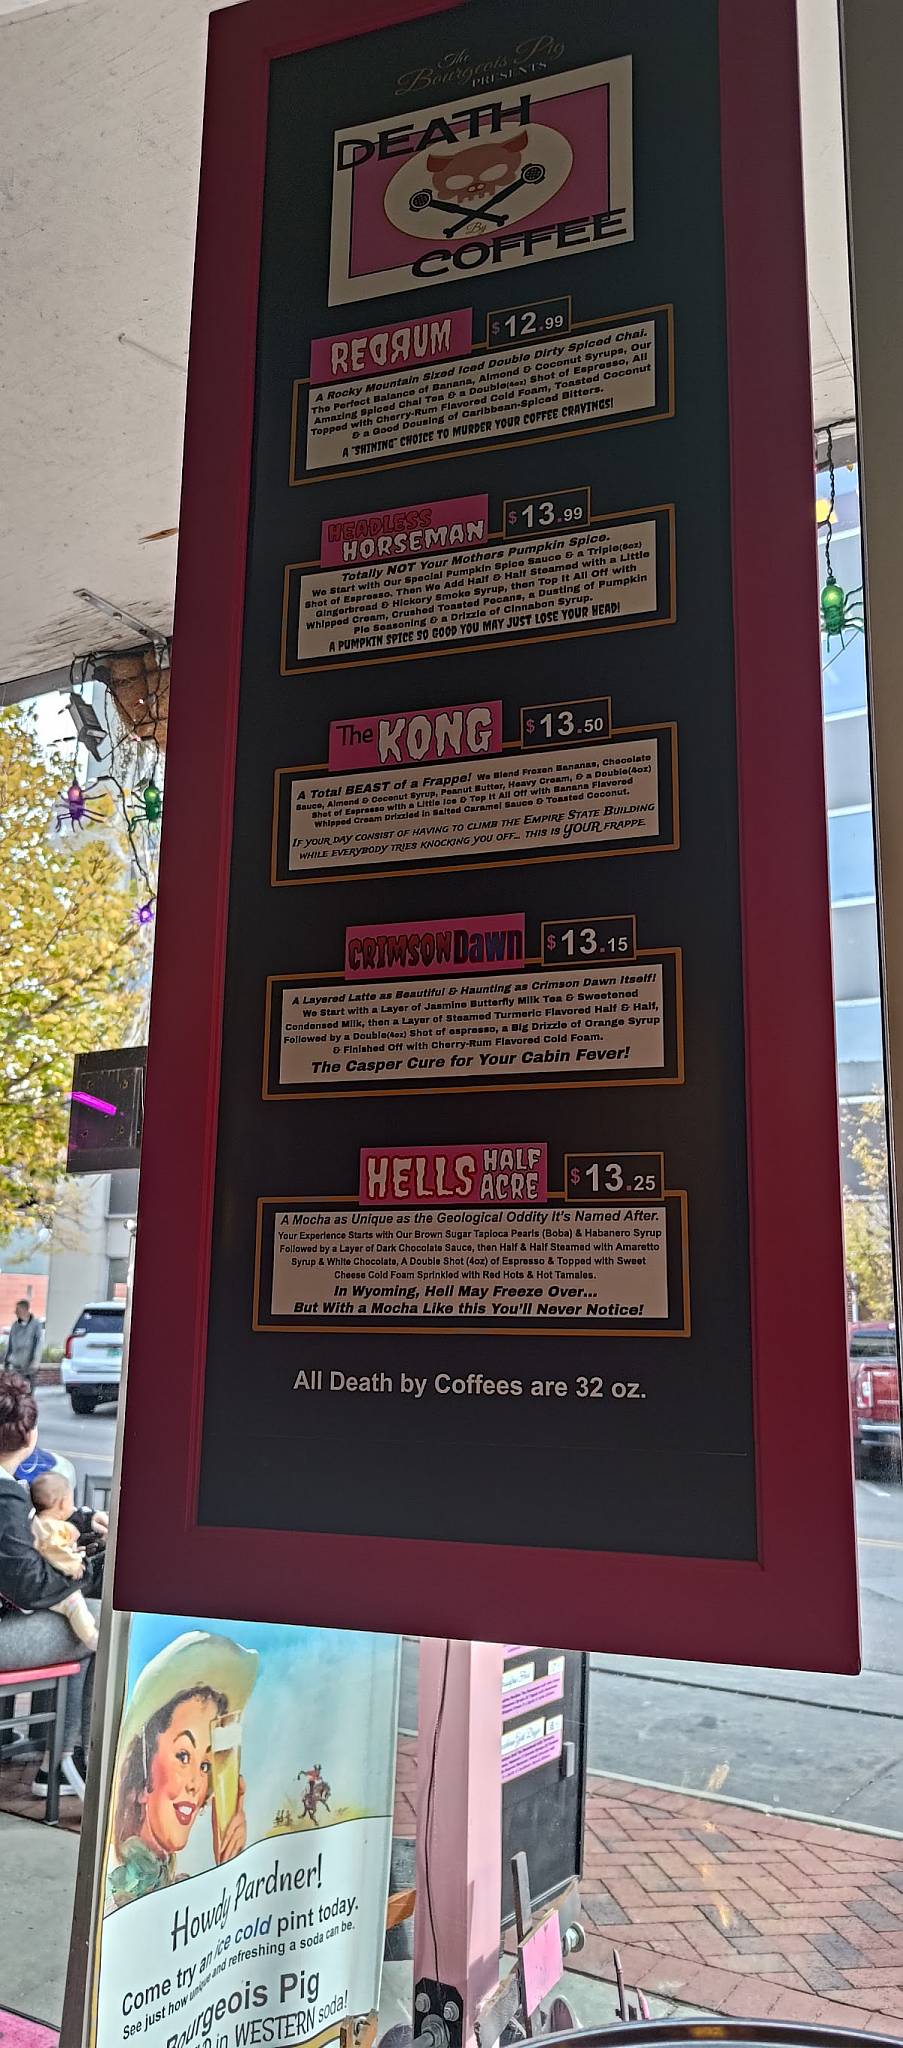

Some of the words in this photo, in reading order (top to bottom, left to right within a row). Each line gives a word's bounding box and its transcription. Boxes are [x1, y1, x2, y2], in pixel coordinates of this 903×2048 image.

[393, 56, 508, 96] Bourgeois
[514, 35, 564, 64] Pig
[438, 48, 471, 68] The
[472, 63, 546, 88] PRESENTS
[336, 94, 532, 171] DEATH
[411, 208, 627, 278] COFFEE
[314, 392, 324, 402] A
[326, 386, 363, 400] Rocky
[364, 375, 420, 393] Mountain
[422, 366, 456, 381] Sized
[457, 360, 486, 375] Iced
[487, 352, 531, 369] Double
[533, 346, 565, 360] Dirty
[567, 334, 612, 353] Spiced
[614, 327, 648, 342] Chai.
[331, 319, 452, 375] REDRUM
[310, 421, 348, 436] Topped
[350, 417, 373, 429] with
[375, 405, 438, 424] Cherry-Rum
[440, 395, 487, 412] Flavored
[489, 389, 515, 402] Cold
[517, 385, 551, 397] Foam,
[553, 372, 600, 390] Toasted
[602, 362, 651, 380] Coconut
[341, 447, 349, 458] A
[351, 437, 398, 456] "SHINING"
[399, 430, 434, 447] CHOICE
[436, 427, 449, 440] TO
[452, 420, 492, 438] MURDER
[494, 415, 521, 430] YOUR
[523, 407, 559, 425] COFFEE
[561, 396, 613, 418] CRAVINGS!
[327, 508, 433, 542] HEADLESS
[342, 519, 485, 563] HORSEMAN
[340, 567, 384, 582] Totally
[385, 561, 417, 576] NOT
[420, 558, 449, 570] Your
[450, 550, 505, 566] Mothers
[507, 539, 565, 557] Pumpkin
[568, 533, 611, 548] Spice.
[328, 641, 335, 653] A
[337, 634, 383, 652] PUMPKIN
[385, 630, 414, 645] SPICE
[416, 628, 429, 641] SO
[431, 625, 458, 639] GOOD
[459, 621, 480, 635] YOU
[482, 617, 505, 632] MAY
[506, 613, 532, 629] JUST
[534, 610, 559, 624] LOSE
[560, 606, 589, 621] YOUR
[591, 601, 620, 616] HEAD!
[337, 724, 373, 746] The
[377, 707, 492, 763] KONG
[296, 790, 306, 801] A
[309, 786, 342, 799] Total
[344, 780, 391, 795] BEAST
[393, 779, 408, 790] of
[409, 780, 419, 789] a
[422, 772, 472, 788] Frappe!
[476, 772, 491, 781] We
[492, 768, 520, 779] Blend
[522, 766, 553, 776] Frozen
[555, 761, 600, 772] Bananas,
[601, 754, 651, 767] Chocolate
[291, 996, 300, 1005] A
[302, 993, 346, 1006] Layered
[347, 992, 377, 1002] Latte
[378, 992, 393, 1000] as
[394, 987, 446, 999] Beautiful
[447, 986, 459, 996] &
[459, 983, 513, 995] Haunting
[513, 983, 528, 992] as
[531, 980, 580, 990] Crimson
[582, 977, 617, 987] Dawn
[619, 972, 657, 984] Itself!
[311, 1060, 341, 1074] The
[345, 1059, 403, 1074] Casper
[406, 1056, 446, 1069] Cure
[450, 1054, 474, 1067] for
[478, 1053, 518, 1066] Your
[521, 1048, 571, 1064] Cabin
[575, 1045, 631, 1061] Fever!
[366, 1154, 476, 1200] HELLS
[483, 1149, 541, 1170] HALF
[480, 1172, 539, 1201] ACRE
[277, 1231, 298, 1240] Your
[299, 1230, 347, 1242] Experience
[347, 1230, 374, 1239] Starts
[375, 1229, 394, 1239] with
[395, 1230, 413, 1239] Our
[414, 1229, 443, 1239] Brown
[444, 1229, 472, 1240] Sugar
[472, 1228, 509, 1240] Tapioca
[510, 1228, 540, 1238] Pearls
[541, 1228, 573, 1240] (Boba)
[575, 1228, 582, 1237] &
[584, 1227, 631, 1238] Habanero
[632, 1228, 662, 1239] Syrup
[293, 1301, 319, 1313] But
[322, 1301, 354, 1314] With
[357, 1304, 367, 1314] a
[370, 1301, 418, 1314] Mocha
[422, 1301, 454, 1314] Like
[458, 1301, 486, 1314] this
[491, 1302, 533, 1315] You'll
[536, 1303, 582, 1315] Never
[585, 1303, 645, 1316] Notice!
[333, 1284, 348, 1297] In
[352, 1284, 420, 1300] Wyoming,
[424, 1284, 455, 1297] Hell
[457, 1285, 489, 1300] May
[492, 1285, 543, 1297] Freeze
[547, 1285, 598, 1298] Over...
[293, 1370, 323, 1391] All
[330, 1370, 393, 1392] Death
[400, 1374, 427, 1397] by
[434, 1372, 522, 1395] Coffees
[531, 1379, 569, 1396] are
[576, 1376, 603, 1397] 32
[611, 1380, 646, 1398] oz.
[171, 1887, 230, 1951] Howdy
[234, 1853, 322, 1913] Pardner!
[122, 1980, 171, 2016] Come
[177, 1963, 196, 1989] try
[200, 1949, 212, 1973] an
[214, 1936, 230, 1963] ice
[235, 1915, 272, 1944] cold
[278, 1909, 314, 1937] pint
[319, 1897, 359, 1922] today.
[123, 2021, 141, 2040] See
[145, 2005, 166, 2032] just
[168, 1992, 189, 2016] how
[190, 1973, 210, 2002] unique
[212, 1959, 226, 1978] and
[229, 1940, 285, 1967] refreshing
[290, 1940, 296, 1951] a
[300, 1934, 323, 1949] soda
[326, 1927, 338, 1940] can
[341, 1920, 355, 1933] be.
[280, 1971, 320, 2003] Pig
[236, 2010, 315, 2047] WESTERN
[318, 1990, 348, 2023] soda!
